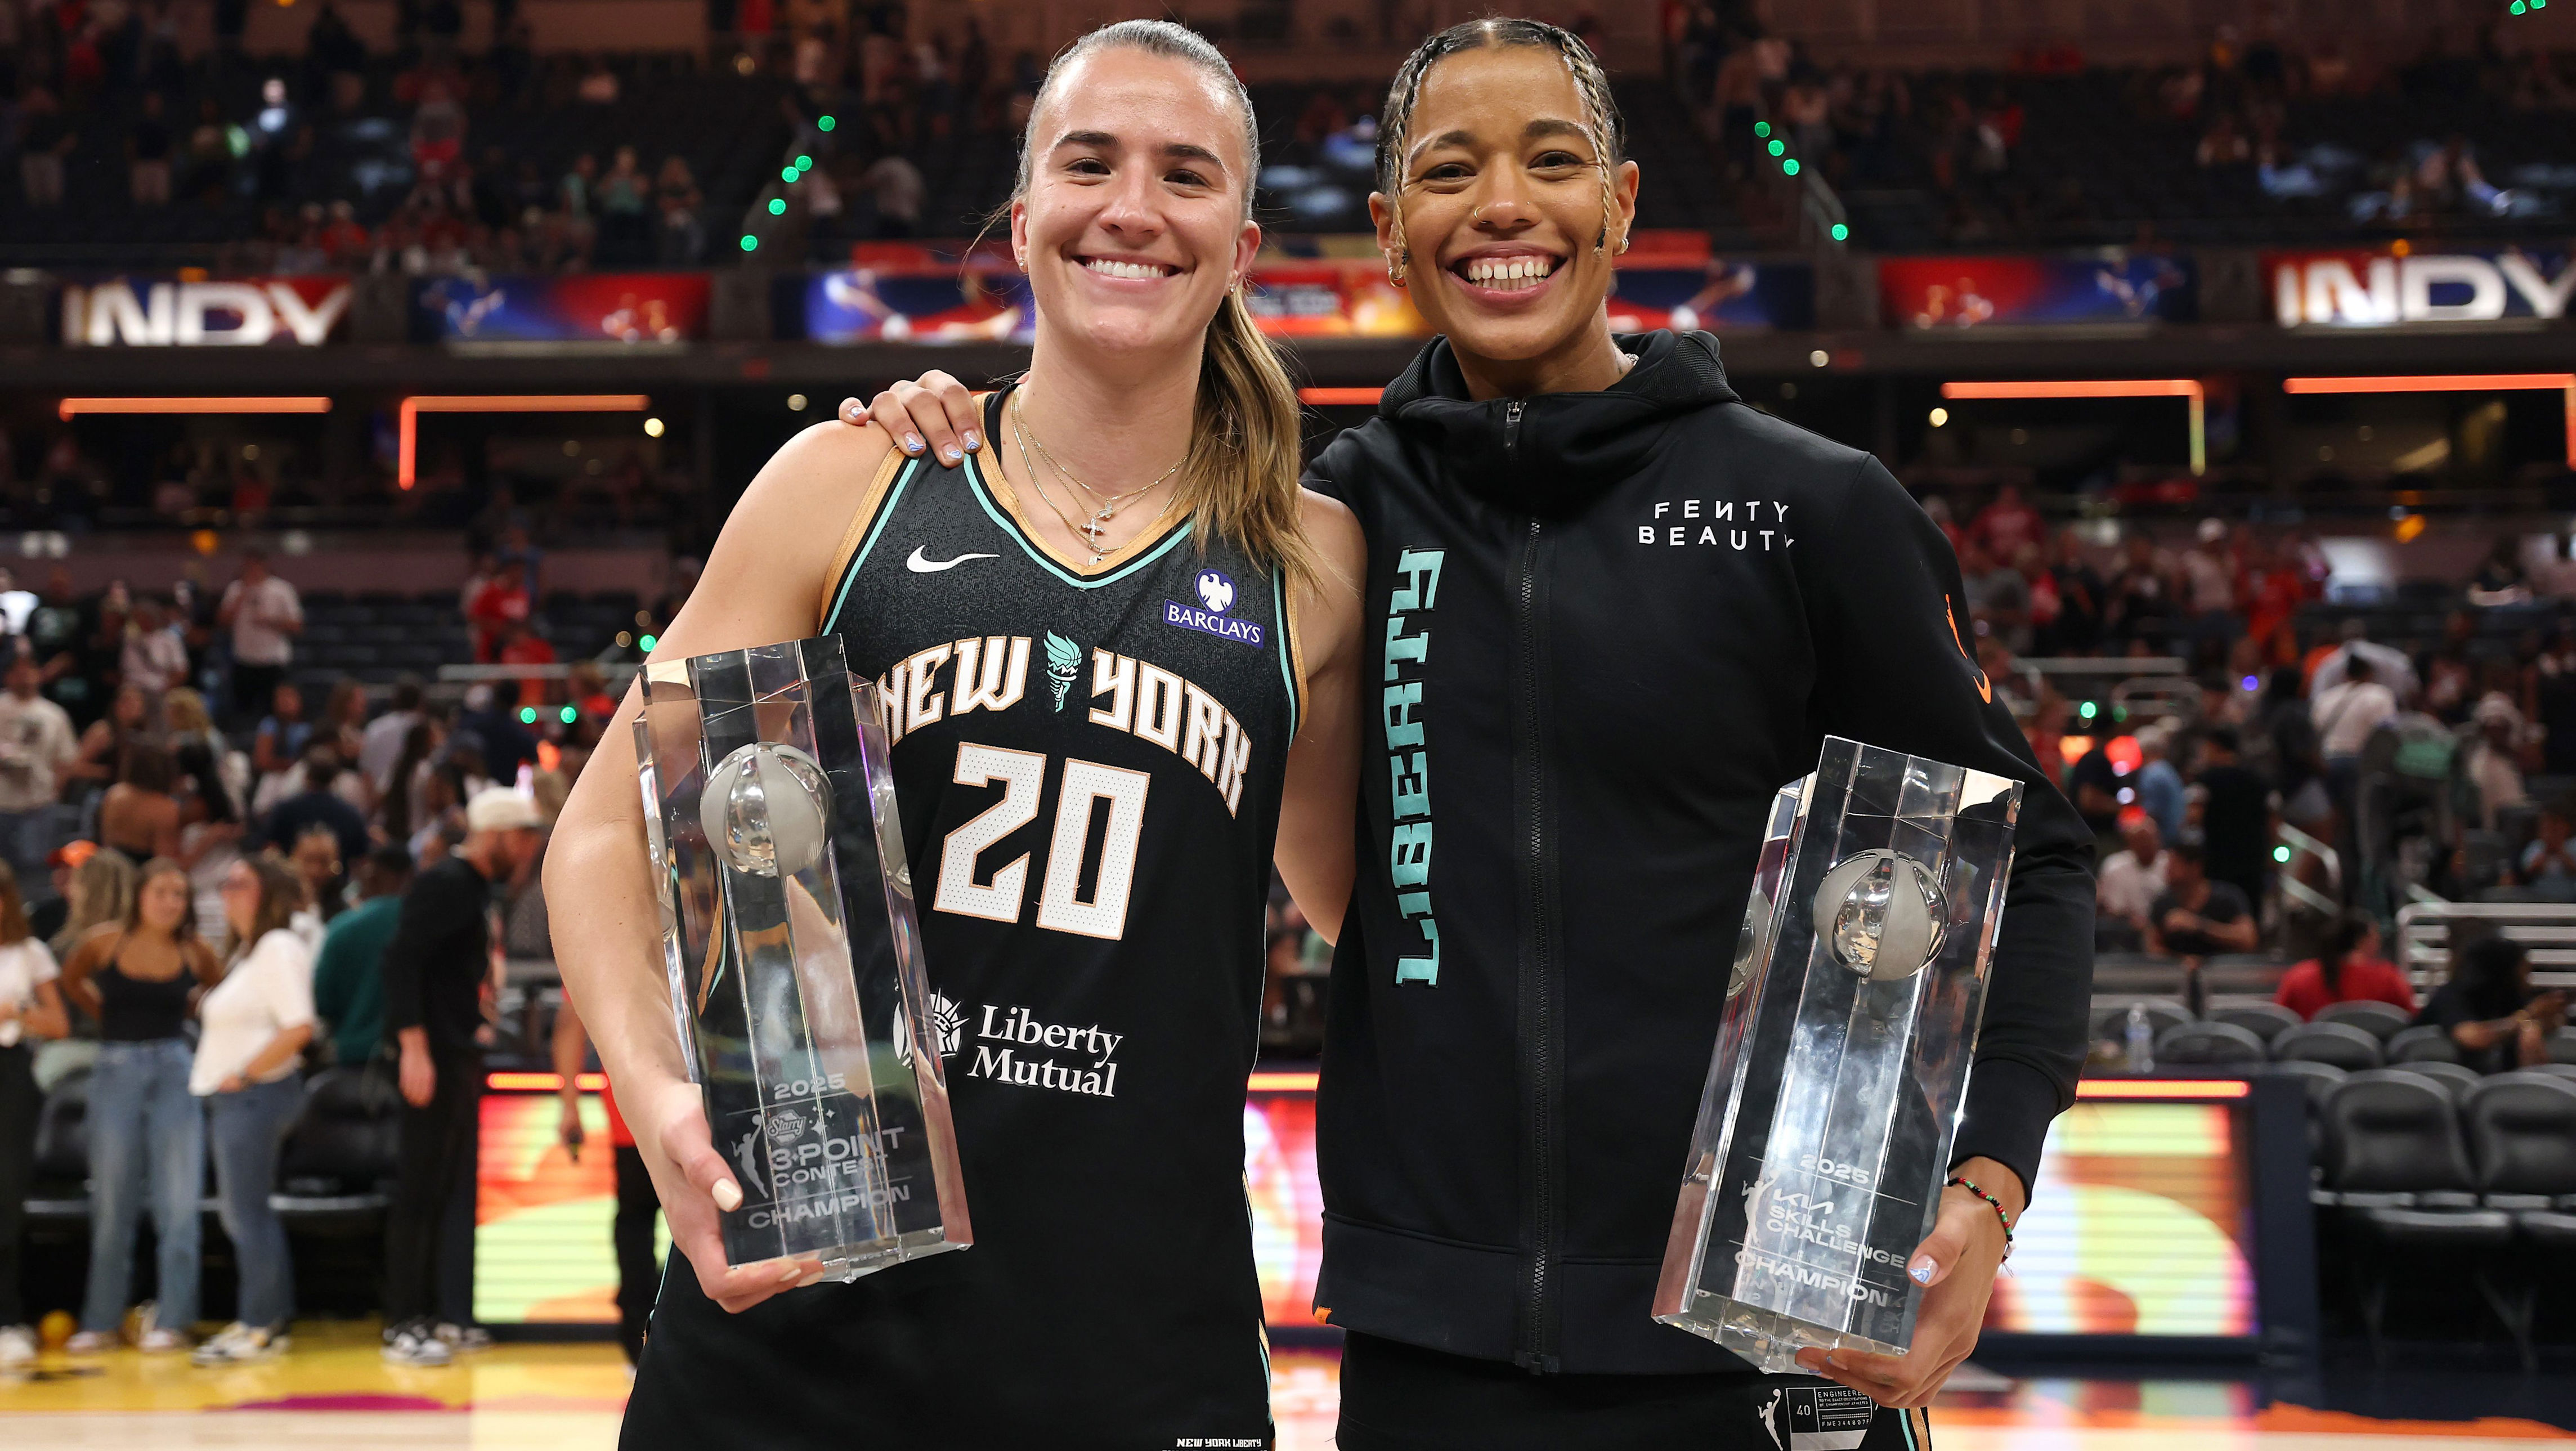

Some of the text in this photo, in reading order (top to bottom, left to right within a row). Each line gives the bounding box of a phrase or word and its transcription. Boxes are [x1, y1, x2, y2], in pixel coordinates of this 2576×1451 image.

[2275, 254, 2576, 328] INDY
[62, 281, 352, 347] INDY
[1655, 500, 1789, 522] FENTY
[1638, 526, 1794, 551] BEAUTY
[1168, 604, 1261, 643] BARCLAYS
[876, 637, 1252, 819] NEW YORK
[1384, 548, 1445, 986] LIBERTY
[933, 741, 1151, 941] 20
[978, 1004, 1123, 1069] Liberty
[774, 1073, 845, 1100] 2025
[967, 1045, 1118, 1098] Mutual
[768, 1116, 807, 1136] Starry
[774, 1154, 888, 1188] CONTEST
[1800, 1154, 1869, 1185] 2025
[748, 1185, 911, 1229] CHAMPION
[1769, 1206, 1852, 1238] SKILLS
[1766, 1219, 1906, 1268] CHALLENGE
[1735, 1251, 1889, 1307] CHAMPION
[1796, 1404, 1811, 1416] 40
[1176, 1438, 1262, 1448] NEW YORK LIBERTY
